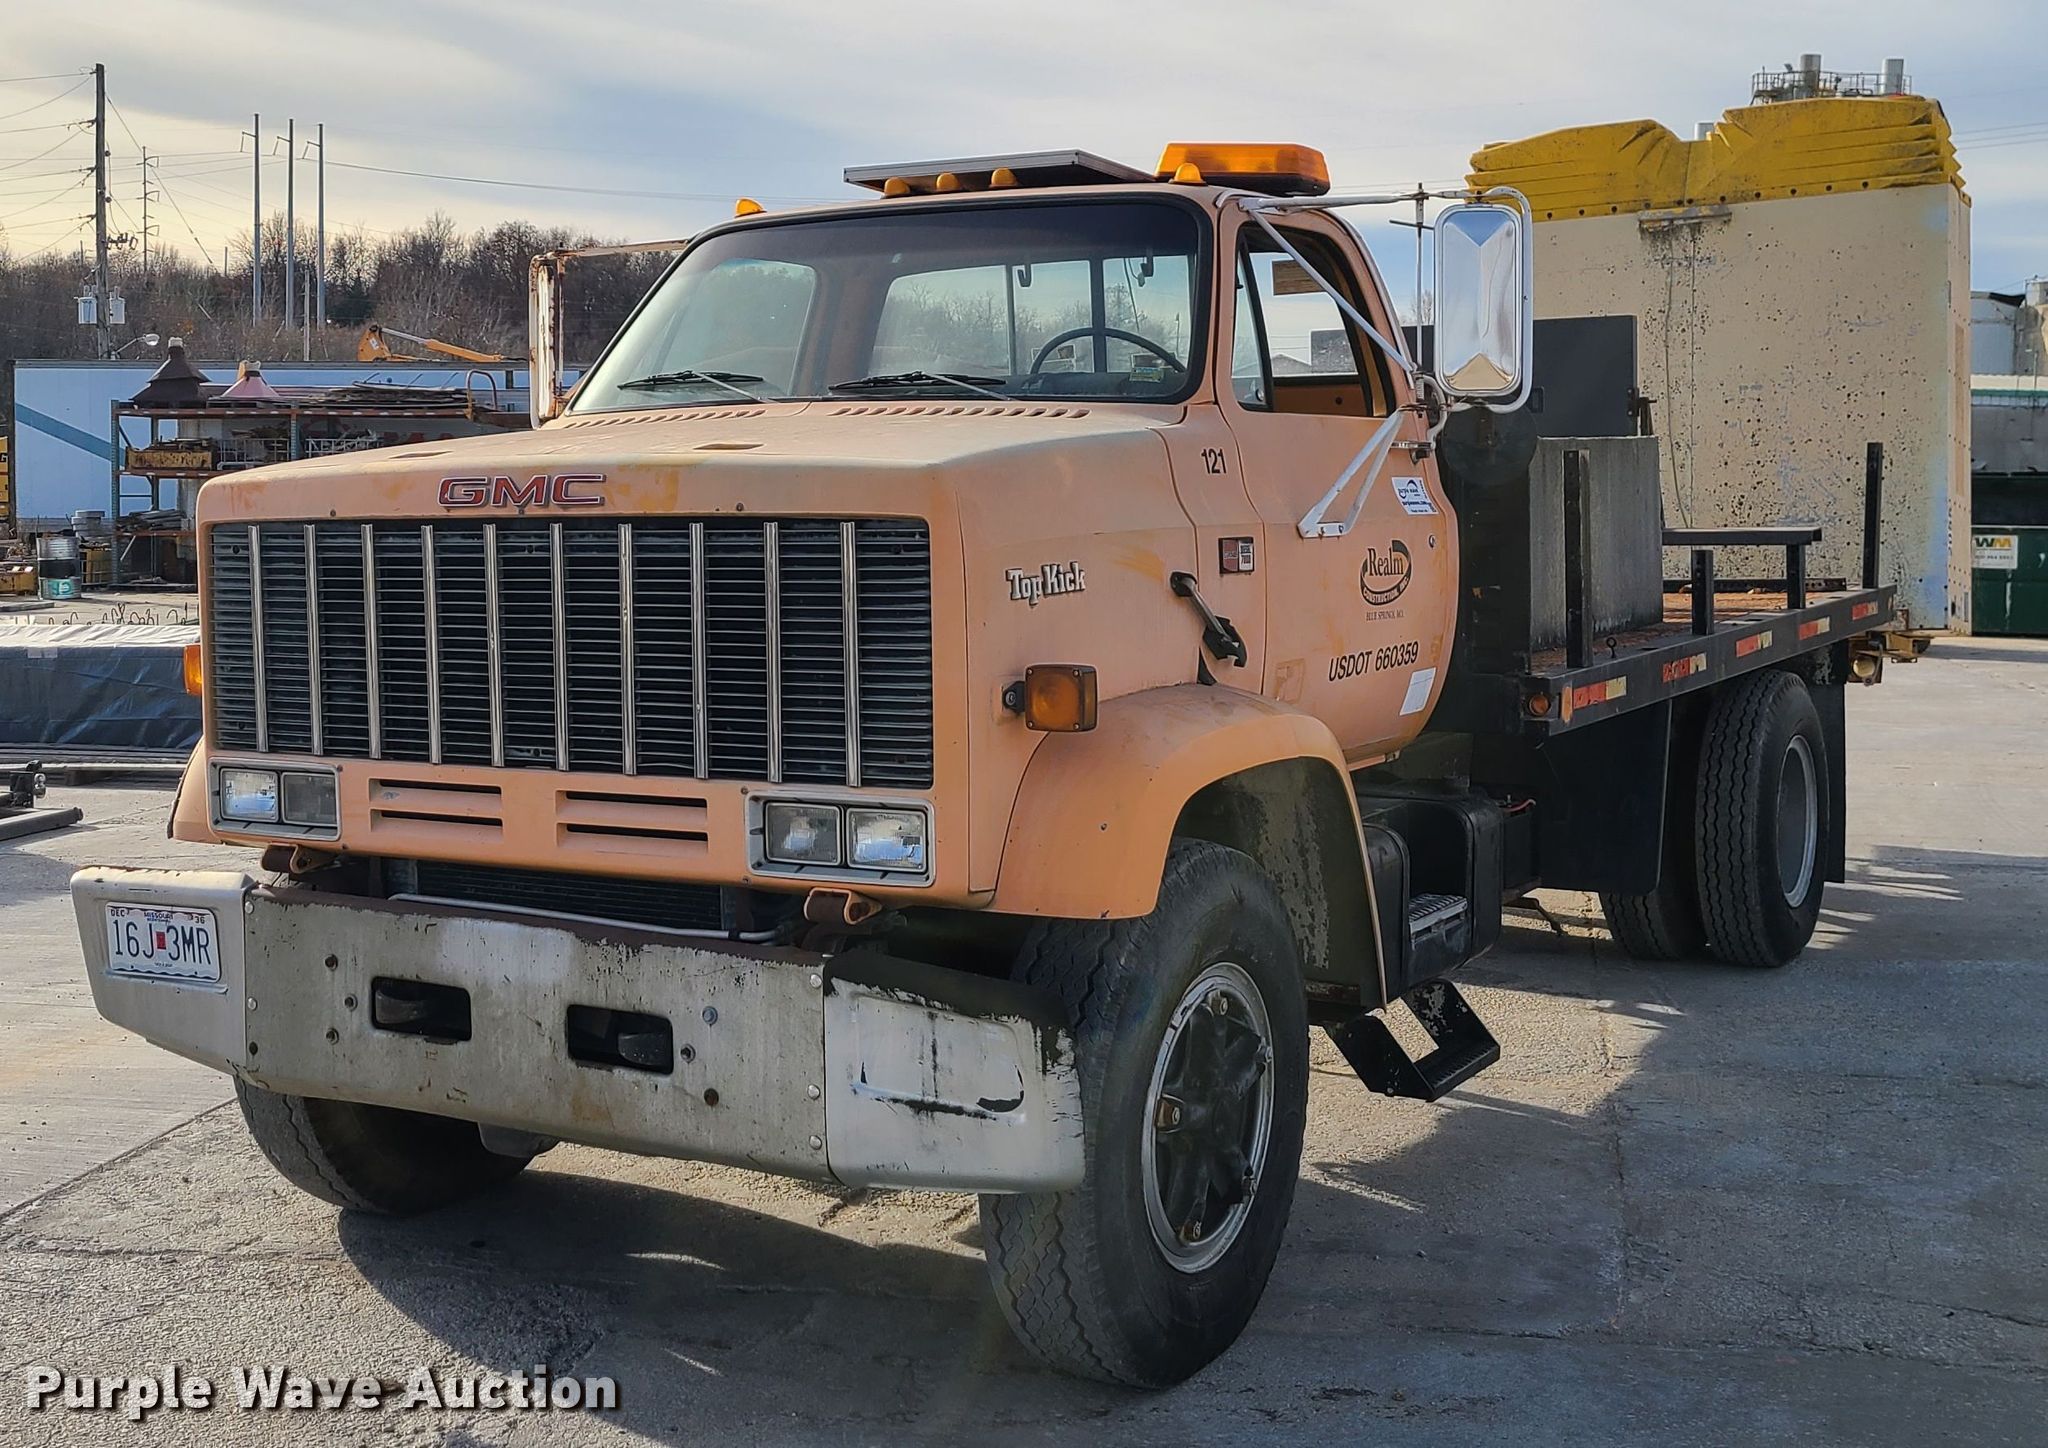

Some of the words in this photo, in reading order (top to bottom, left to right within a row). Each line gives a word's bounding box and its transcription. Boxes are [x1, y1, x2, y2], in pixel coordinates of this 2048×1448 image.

[1201, 449, 1226, 474] 121
[437, 474, 606, 507] GMC
[1975, 537, 2012, 548] WM
[1367, 547, 1404, 577] Realm
[1329, 650, 1373, 682] USDOT
[1375, 640, 1419, 671] 660359
[110, 908, 126, 917] DEC
[113, 920, 154, 958] 16J
[166, 925, 211, 965] 3MR
